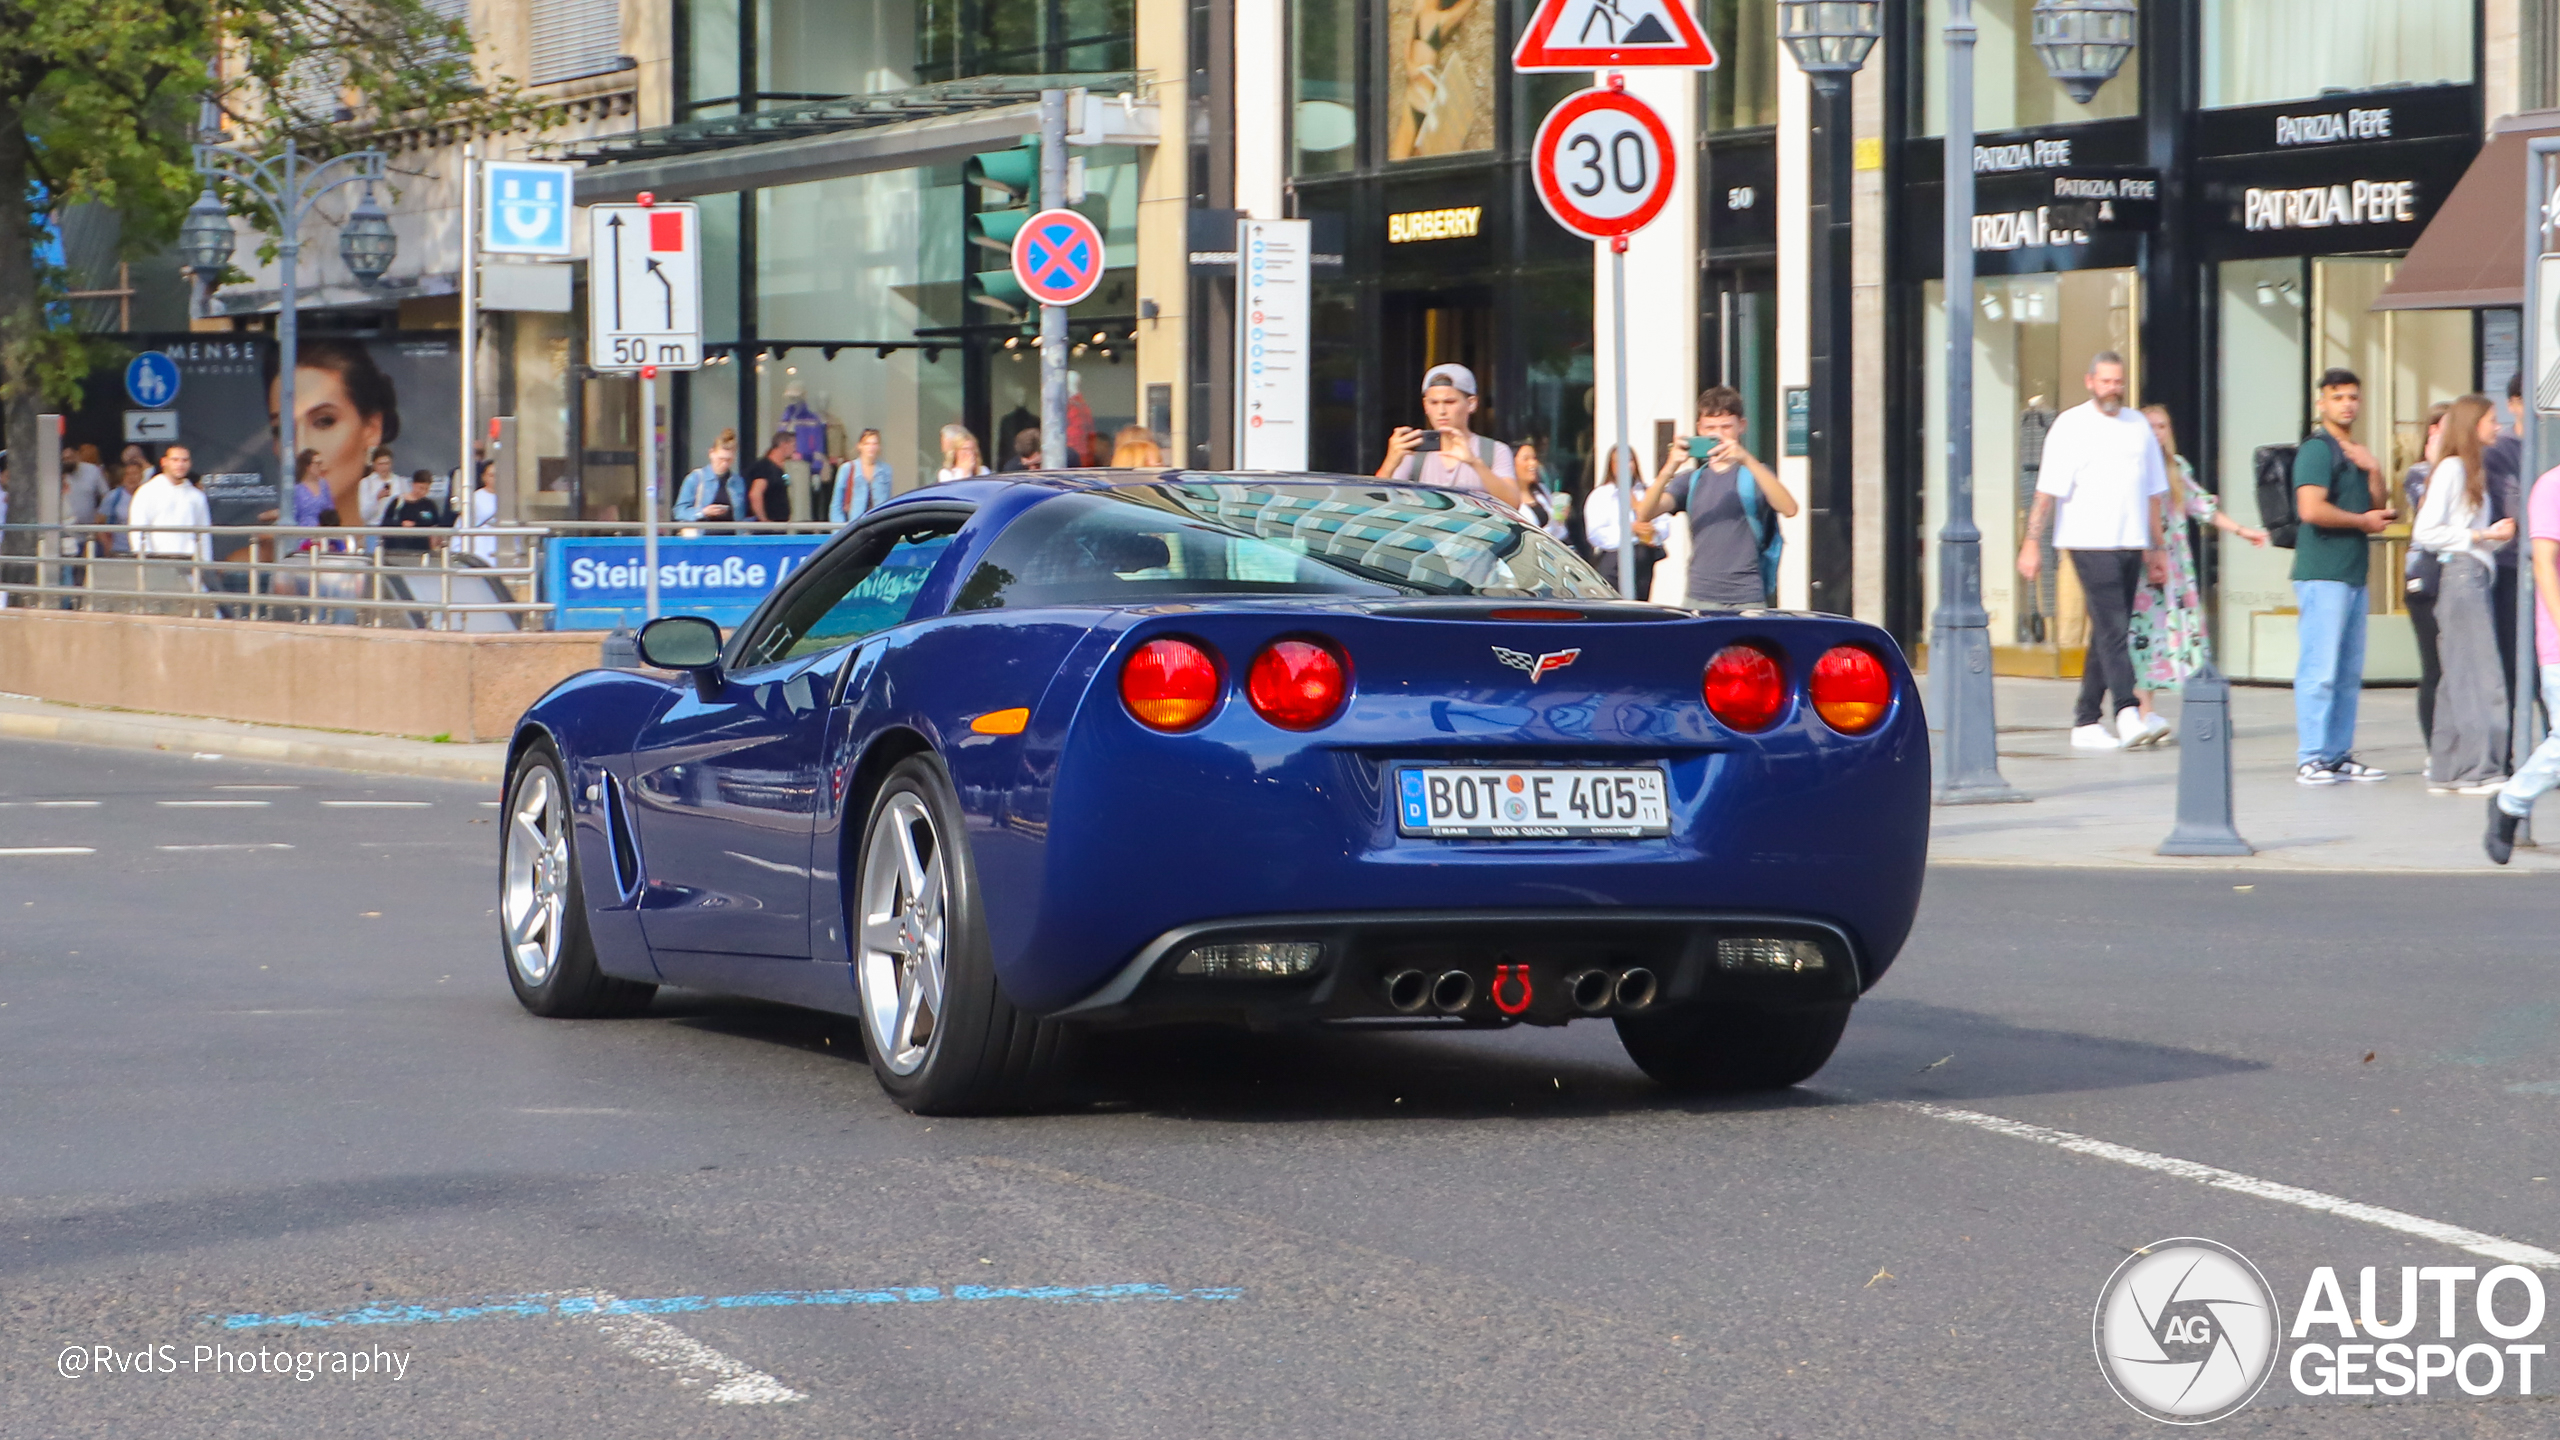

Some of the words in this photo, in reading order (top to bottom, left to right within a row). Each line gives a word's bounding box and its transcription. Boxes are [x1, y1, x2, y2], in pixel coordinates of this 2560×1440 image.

[2276, 111, 2346, 146] PATRIZIA
[2347, 107, 2392, 139] PEPE
[1568, 129, 1646, 197] 30
[1973, 142, 2033, 172] PATRIZIA
[2033, 138, 2072, 168] PEPE
[1727, 186, 1755, 210] 50
[2054, 176, 2117, 199] PATRIZIA
[2119, 177, 2156, 199] PEPE
[2244, 184, 2351, 231] PATRIZIA
[2351, 179, 2416, 225] PEPE
[1388, 205, 1483, 243] BURBERRY
[614, 338, 646, 364] 50
[658, 343, 685, 363] m
[1428, 775, 1501, 820] BOT
[1531, 776, 1559, 819] E
[1568, 776, 1637, 819] 405
[1638, 776, 1656, 790] 04
[1409, 803, 1421, 818] D
